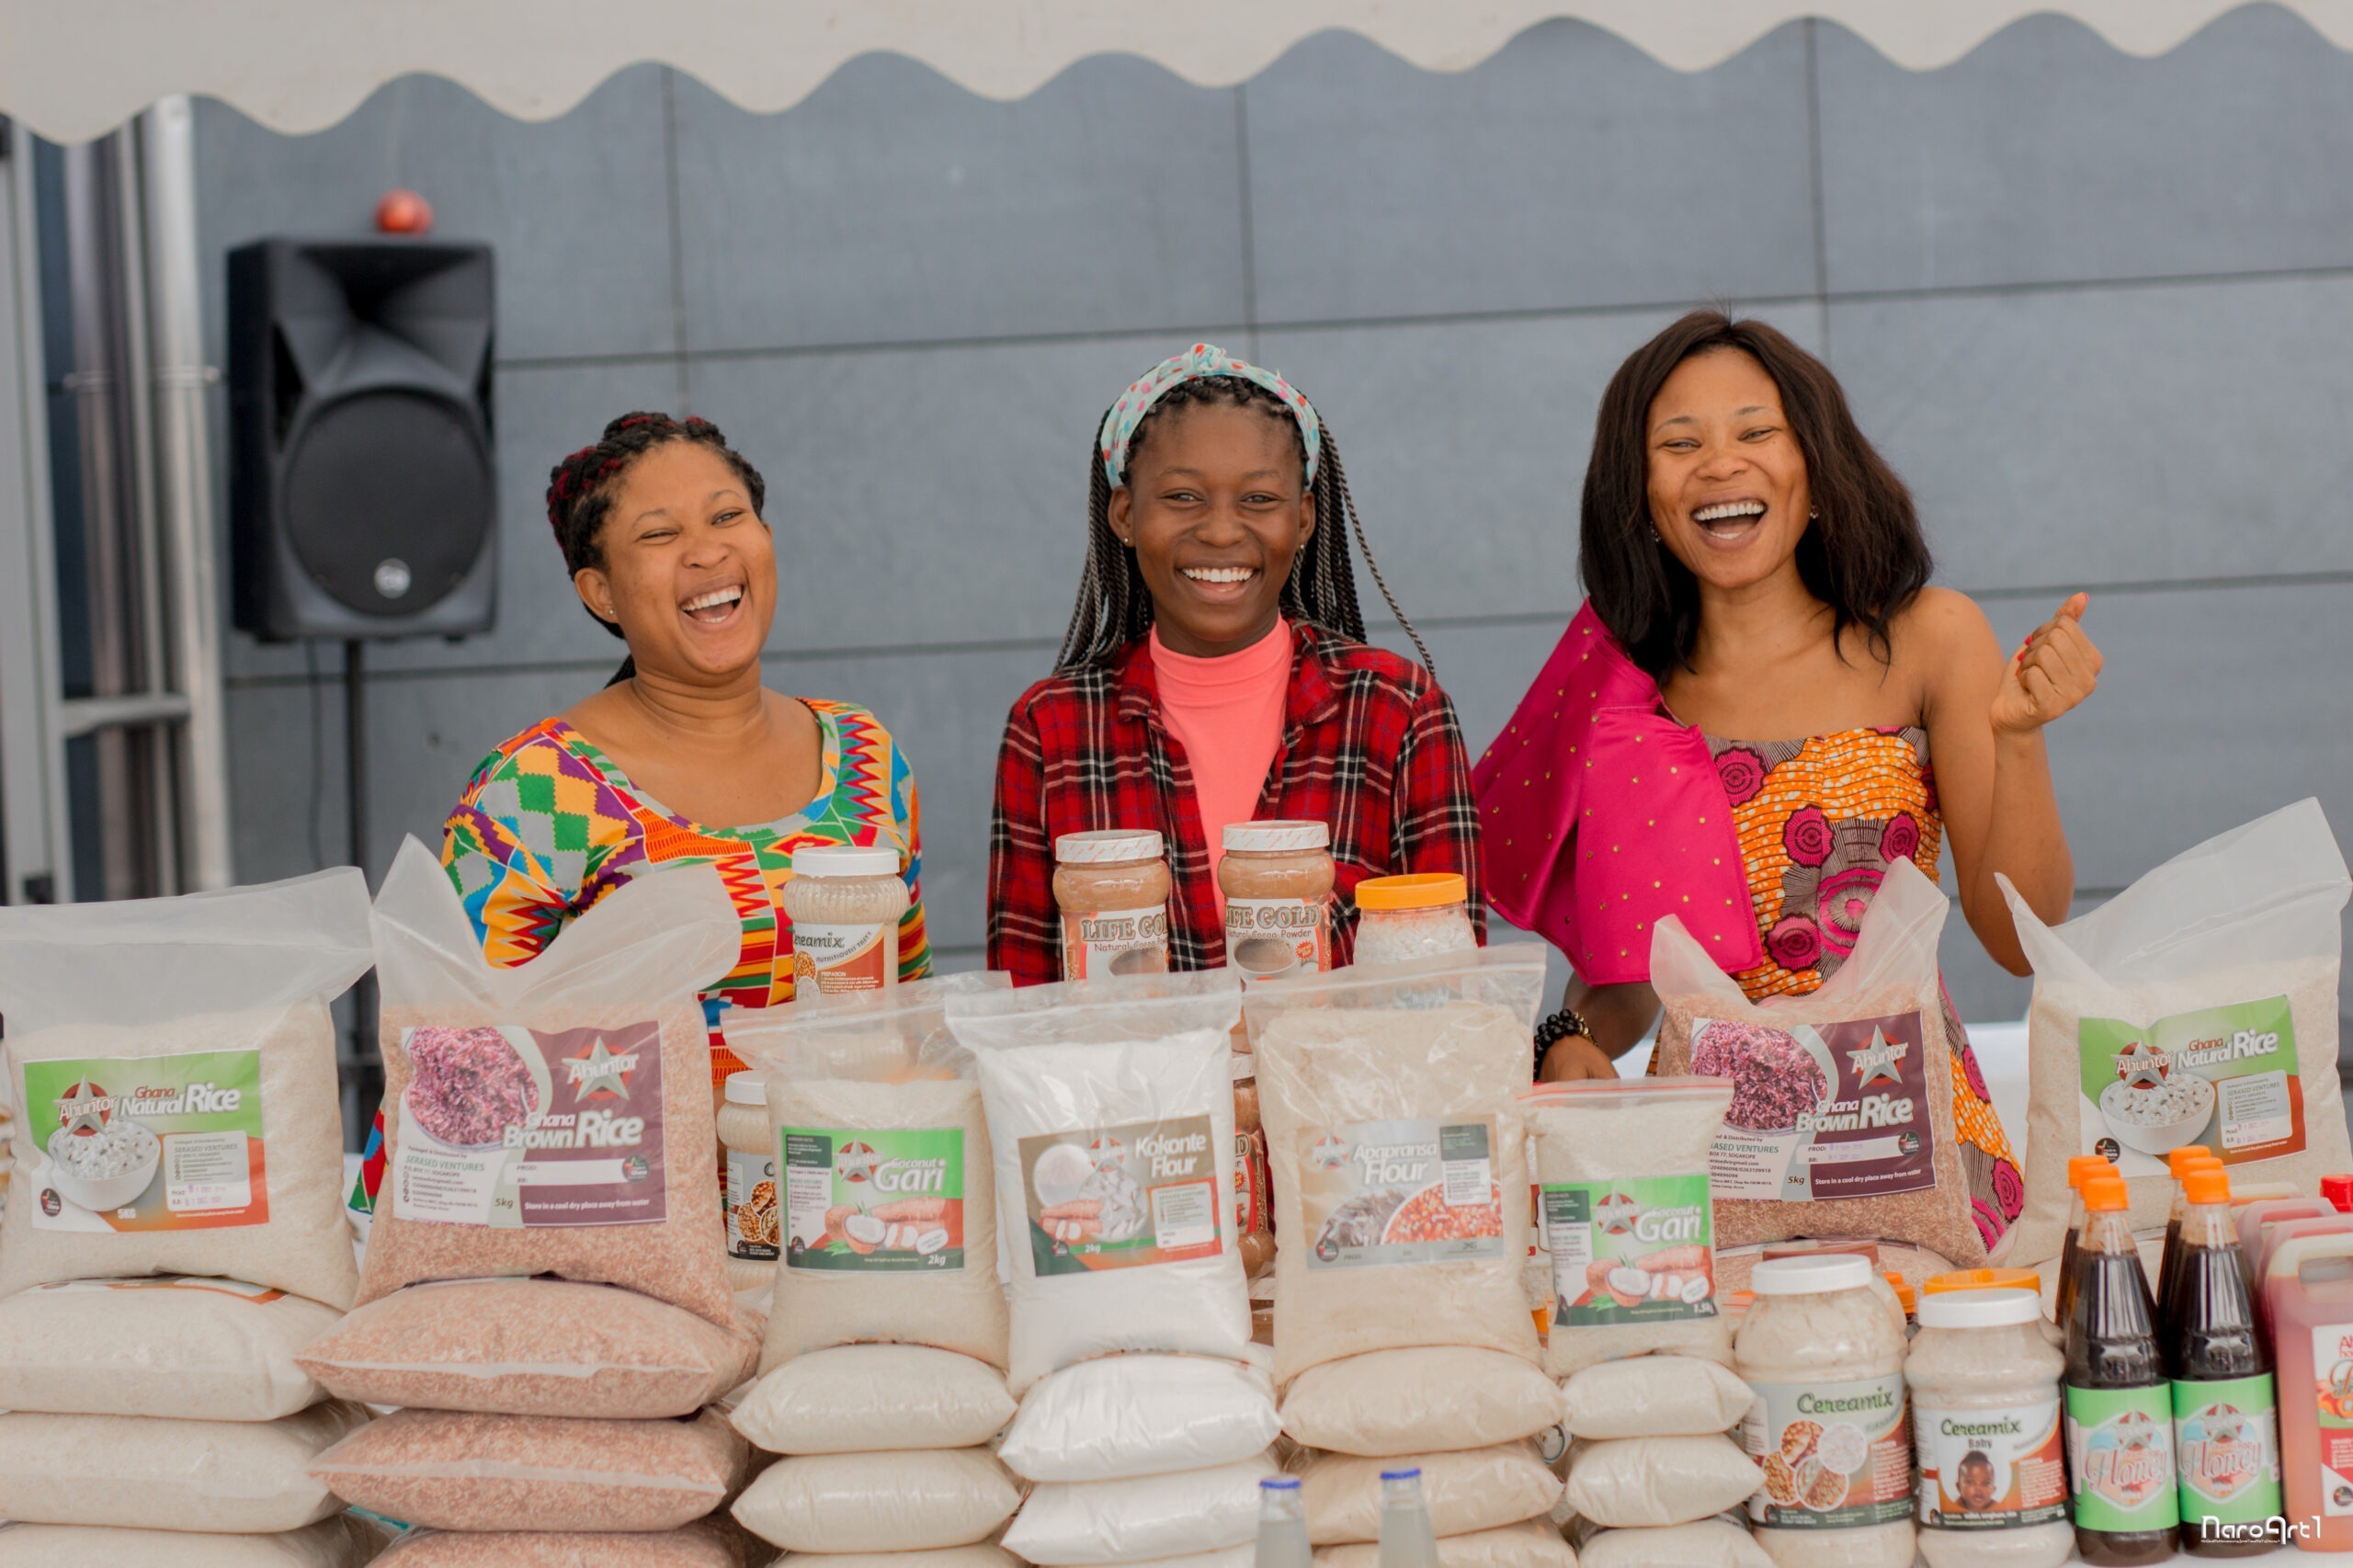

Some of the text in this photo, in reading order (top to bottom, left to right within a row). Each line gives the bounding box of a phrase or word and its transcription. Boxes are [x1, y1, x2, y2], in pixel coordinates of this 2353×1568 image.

[1225, 904, 1319, 929] IFE GOLD
[1082, 912, 1168, 941] LIFE GO
[1252, 930, 1277, 939] Cocoa
[1280, 929, 1312, 938] Powder
[794, 931, 846, 949] ereamix
[1094, 941, 1130, 952] Natural
[1133, 939, 1155, 949] Cocoa
[2176, 1028, 2279, 1070] Natural Rice
[2188, 1036, 2224, 1052] Ghana
[1851, 1041, 1909, 1074] Ahuntor
[2116, 1051, 2174, 1075] Ahuntor
[567, 1052, 640, 1085] Ahuntor
[118, 1082, 242, 1117] Natural Rice
[134, 1085, 176, 1099] Ghana
[58, 1096, 118, 1121] Ahuntor
[1795, 1093, 1914, 1133] Brown Rice
[1816, 1099, 1859, 1115] Ghana
[503, 1108, 644, 1150] Brown Rice
[525, 1111, 575, 1129] Ghana
[204, 1142, 238, 1152] VENTURES
[1134, 1132, 1207, 1158] Kokonte
[1728, 1134, 1756, 1142] Distributed
[1353, 1142, 1438, 1165] Apapransa
[1711, 1142, 1779, 1153] ASED VENTURES
[405, 1154, 485, 1172] SERASED VENTURES
[892, 1156, 938, 1169] Coconut
[1151, 1154, 1198, 1179] Flour
[874, 1157, 947, 1192] Gari
[1365, 1160, 1429, 1185] Flour
[1787, 1176, 1805, 1186] 5kg
[1814, 1177, 1831, 1186] Store
[1854, 1176, 1864, 1184] dry
[1864, 1174, 1880, 1183] place
[1893, 1170, 1907, 1178] from
[1907, 1168, 1922, 1176] water
[494, 1198, 514, 1210] 5kg
[524, 1201, 541, 1210] Store
[542, 1201, 550, 1210] in
[554, 1200, 569, 1210] cool
[569, 1200, 580, 1211] dry
[580, 1200, 597, 1210] place
[616, 1199, 631, 1208] from
[1635, 1205, 1702, 1243] Gari
[1085, 1243, 1102, 1255] 2kg
[927, 1254, 947, 1267] 2kg
[1797, 1385, 1893, 1415] Cereamix
[1940, 1416, 2021, 1437] Cereamix
[1968, 1438, 1993, 1449] Baby
